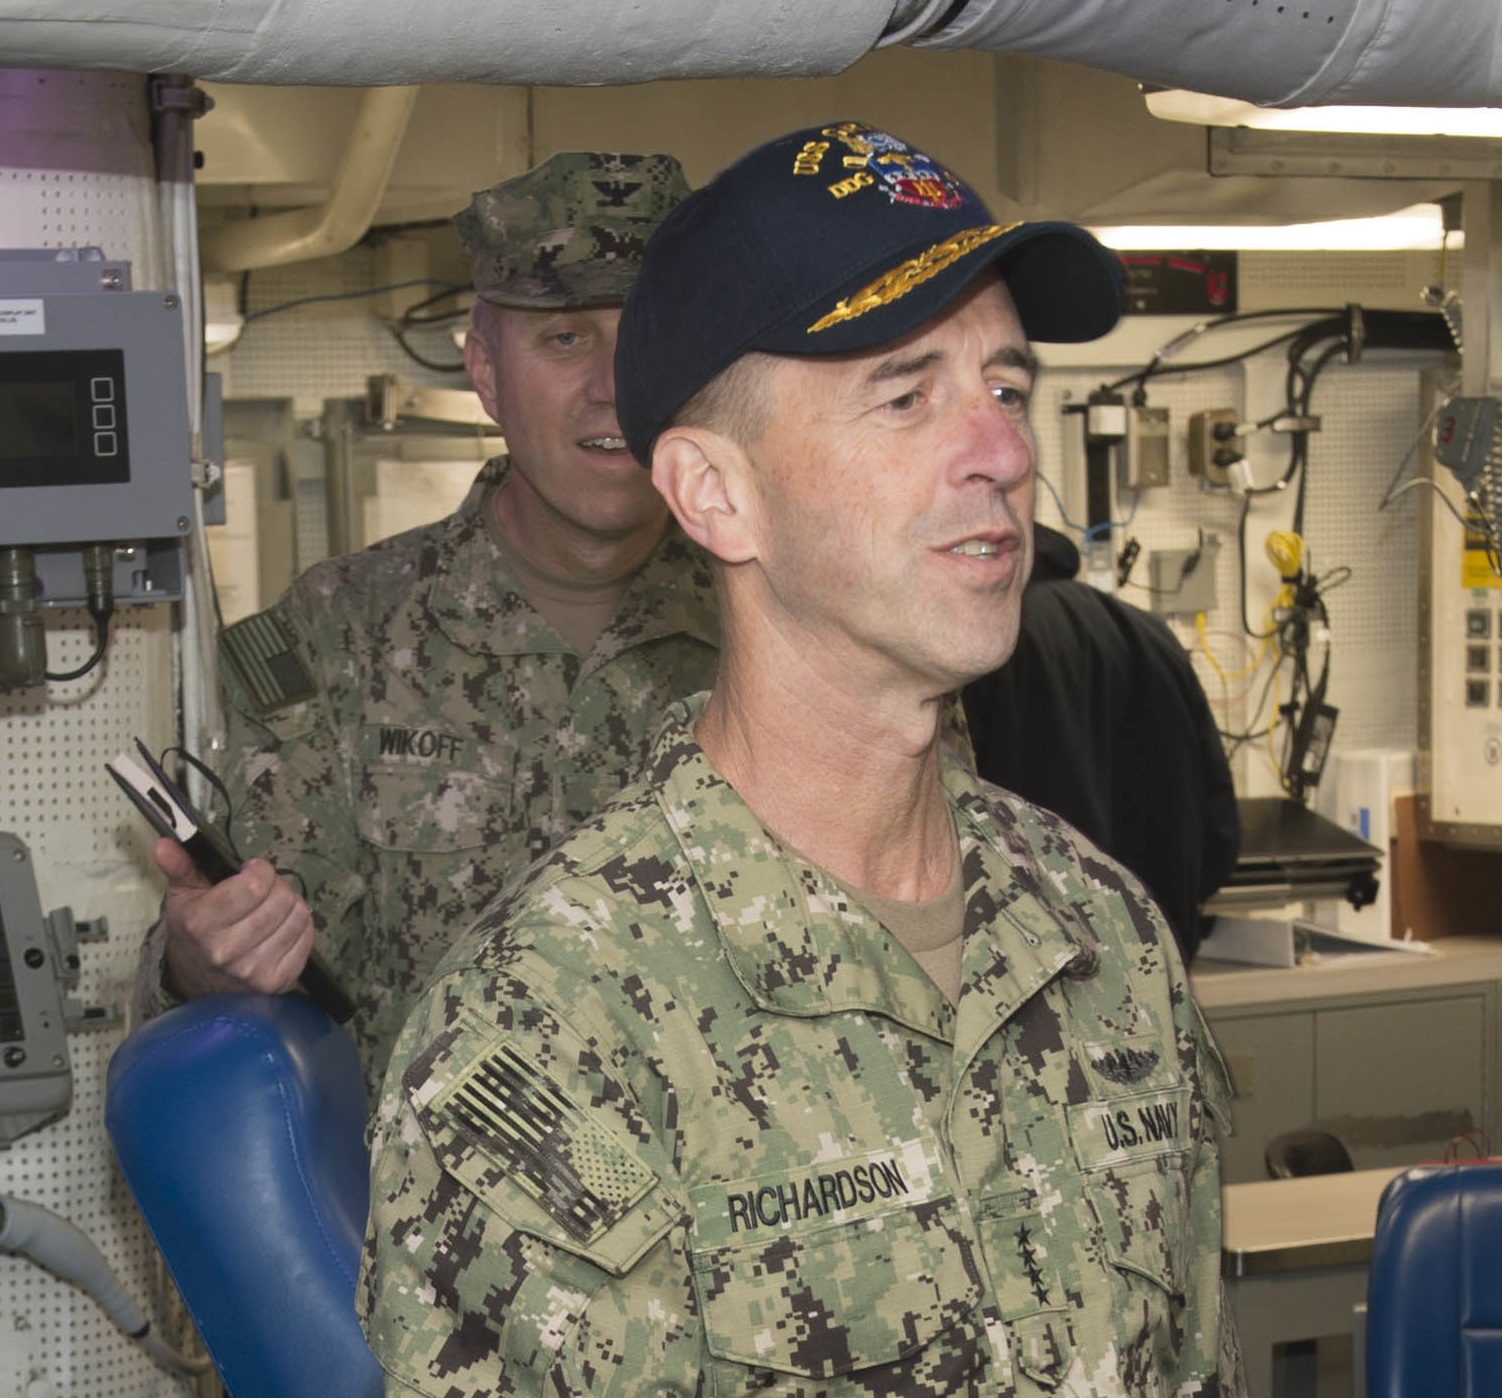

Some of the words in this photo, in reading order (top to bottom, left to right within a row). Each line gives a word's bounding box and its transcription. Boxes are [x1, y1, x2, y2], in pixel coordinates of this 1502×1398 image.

[827, 171, 875, 199] DDG
[379, 727, 465, 760] WIKOFF
[1101, 1109, 1143, 1151] U.S.
[1137, 1101, 1179, 1142] NAVY
[727, 1159, 909, 1233] RICHARDSON
